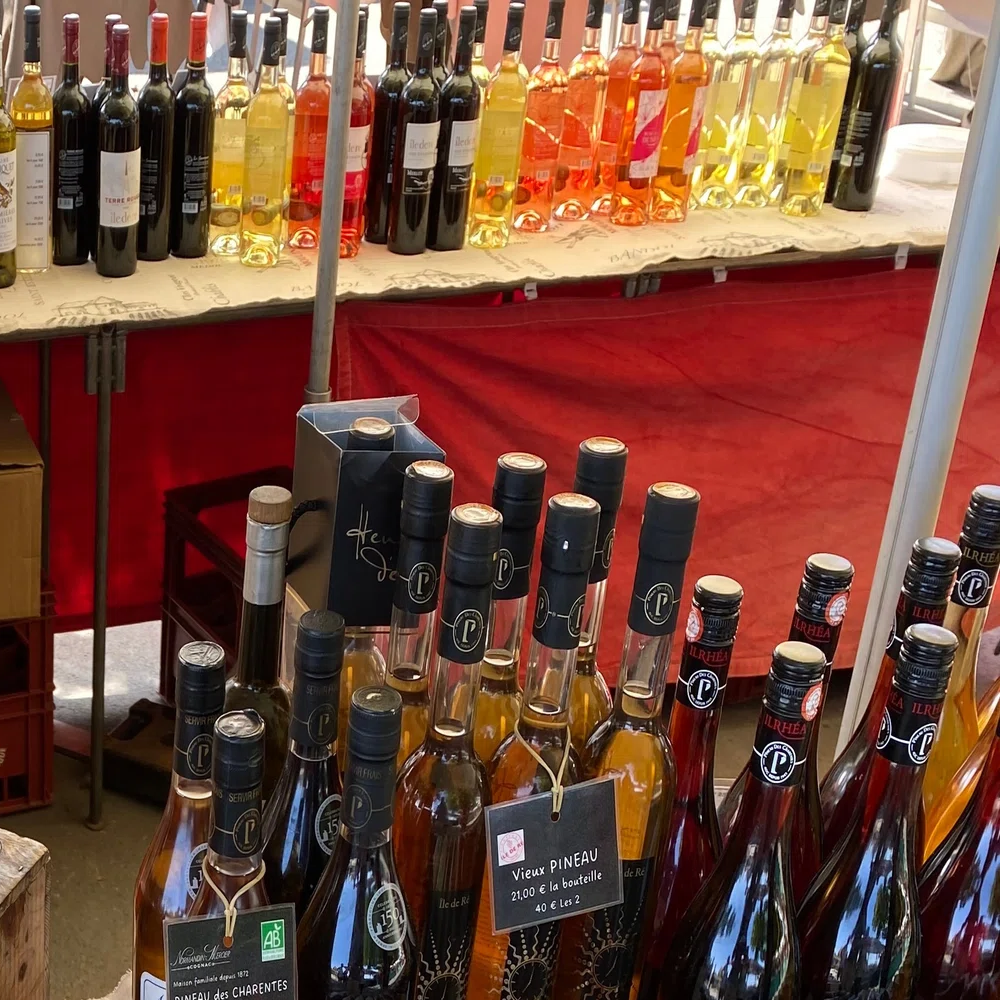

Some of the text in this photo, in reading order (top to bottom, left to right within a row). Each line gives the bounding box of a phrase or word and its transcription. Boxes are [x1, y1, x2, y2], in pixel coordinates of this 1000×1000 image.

[793, 618, 831, 643] ILRHÉA
[184, 714, 208, 726] SERVIR
[763, 715, 807, 740] ILRHÉA
[511, 848, 598, 882] Vieux PINEAU
[511, 870, 602, 902] 21,00 € la bouteille
[535, 894, 580, 913] 40 € Les 2
[380, 907, 400, 927] 150
[173, 970, 249, 988] Maison familiale depuis 1872
[213, 988, 229, 1000] des
[232, 979, 288, 998] CHARENTES
